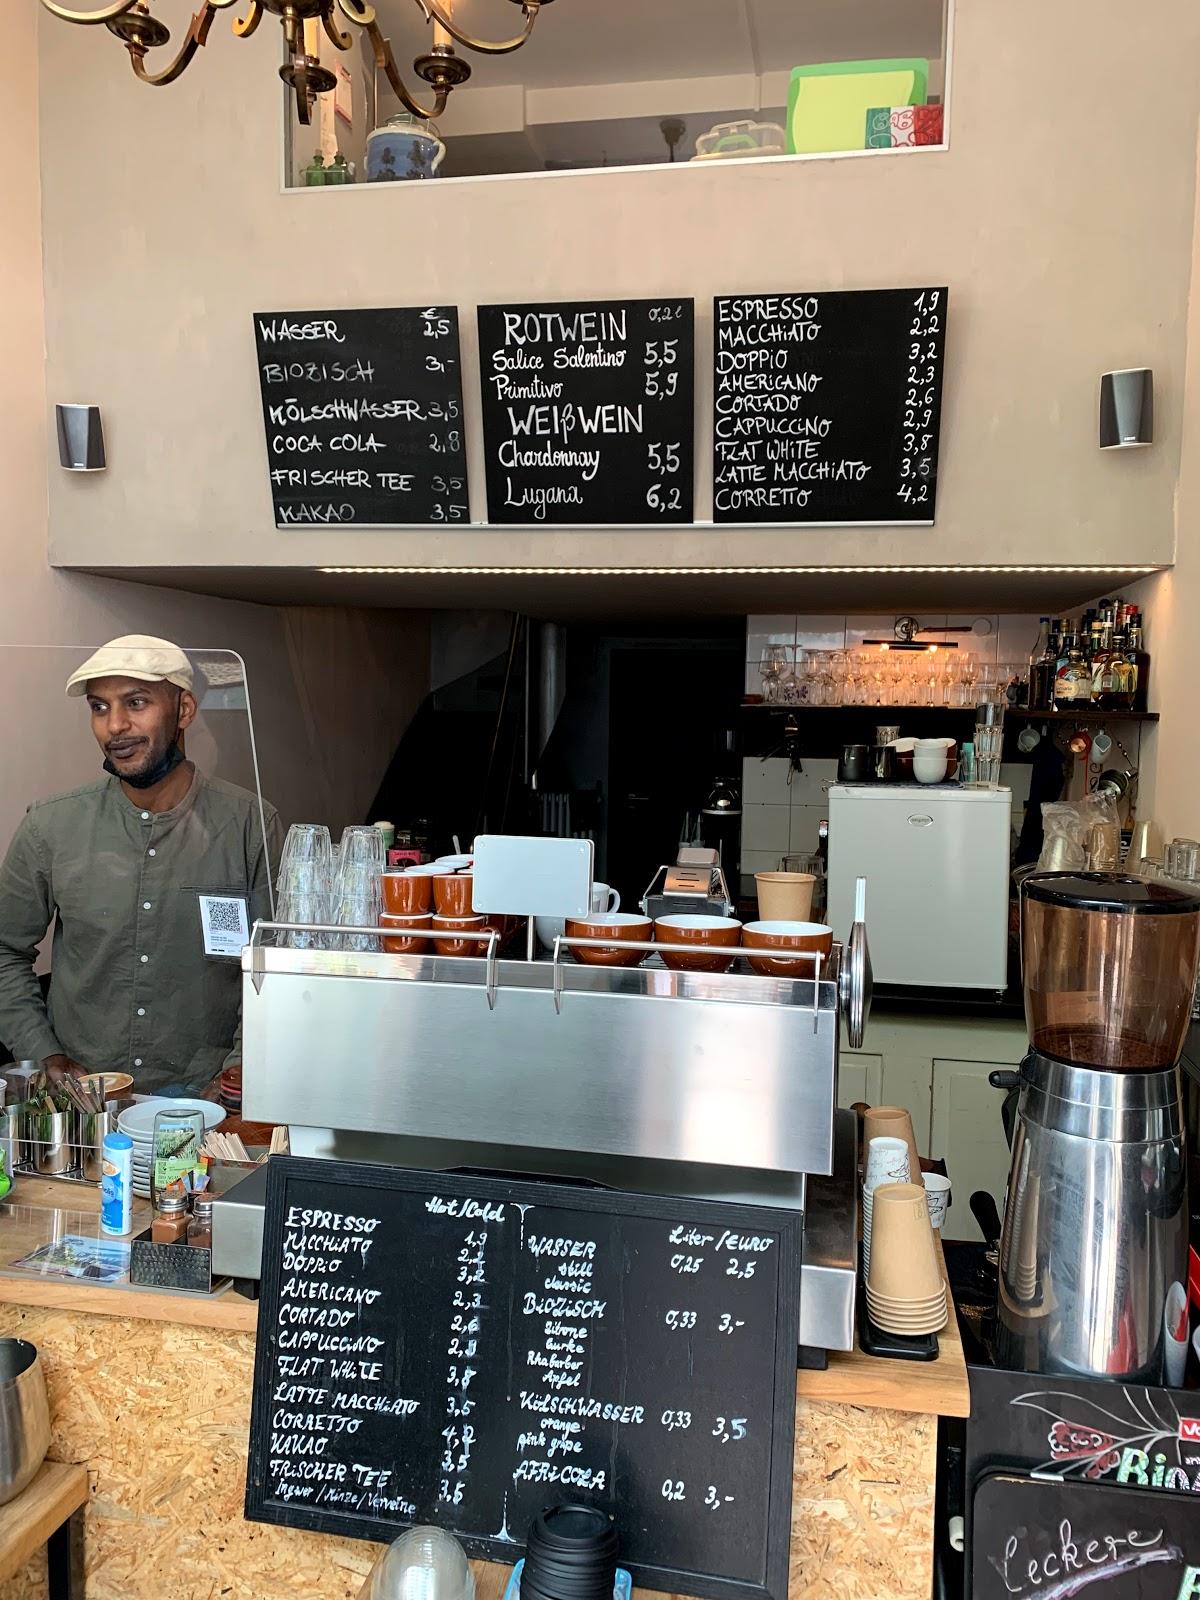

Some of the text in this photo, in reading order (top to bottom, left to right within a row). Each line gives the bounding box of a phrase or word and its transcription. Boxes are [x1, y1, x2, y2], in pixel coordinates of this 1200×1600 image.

[719, 291, 940, 322] ESPRESSO 1,9
[260, 319, 449, 342] WASSER 2,5
[503, 309, 627, 345] ROTWEIN
[909, 315, 940, 336] 2,2
[492, 342, 627, 371] Salice Salentino
[644, 339, 679, 368] 5,5
[908, 342, 938, 364] 3,2
[263, 359, 375, 383] BIOZISCH
[907, 366, 935, 385] 2,3
[489, 371, 679, 400] Primitivo 5,9
[428, 400, 458, 421] 3,5
[716, 387, 935, 414] CORTADO 2,6
[506, 402, 643, 444] WEIßWEIN
[903, 409, 932, 430] 2,9
[273, 431, 460, 454] COCA COLA 2,8
[715, 440, 763, 461] FLAT
[903, 433, 933, 455] 3,8
[498, 440, 680, 480] Chardonnay 5,5
[715, 465, 767, 484] LATTE
[900, 458, 932, 479] 3,5
[271, 469, 464, 495] FRISCHER TEE 3,5
[504, 476, 682, 520] Lugana 6,2
[715, 484, 929, 511] CORRETTO 4,2
[280, 504, 468, 523] KAKAO 3,5
[284, 1206, 382, 1233] ESPRESSO
[464, 1230, 488, 1248] 1,9
[669, 1225, 714, 1246] Liter
[528, 1235, 757, 1279] WASSER 0,25 2,5
[558, 1260, 593, 1277] still
[457, 1266, 486, 1285] 3,2
[544, 1275, 592, 1294] classic
[452, 1291, 482, 1310] 2,3
[278, 1303, 356, 1328] CORTADO
[665, 1310, 697, 1330] 0,33
[278, 1355, 325, 1377] FLAT
[527, 1350, 584, 1370] Rhabarber
[542, 1369, 581, 1390] Apfel
[273, 1382, 328, 1405] LATTE
[446, 1396, 476, 1417] 3,5
[272, 1408, 364, 1434] CORRETTO
[661, 1410, 692, 1431] 0,33
[712, 1416, 748, 1443] 3,5
[516, 1431, 547, 1453] pink
[442, 1450, 471, 1471] 3,5
[352, 1463, 392, 1488] TEE
[661, 1480, 686, 1501] 0,2
